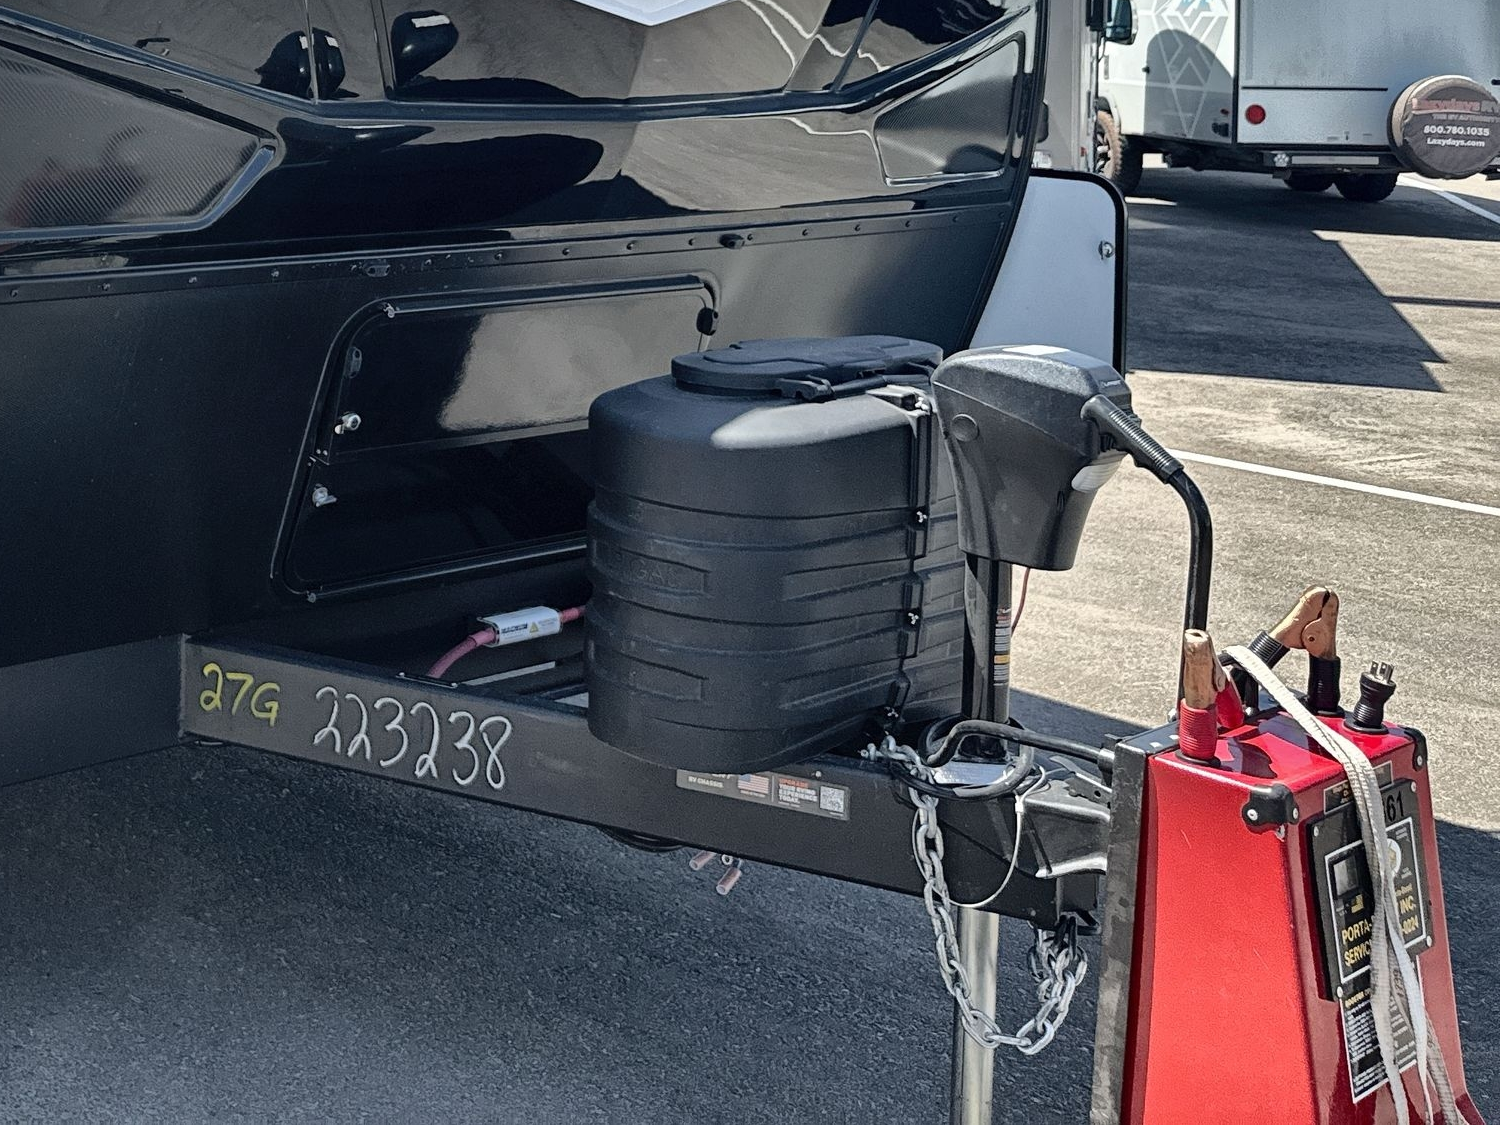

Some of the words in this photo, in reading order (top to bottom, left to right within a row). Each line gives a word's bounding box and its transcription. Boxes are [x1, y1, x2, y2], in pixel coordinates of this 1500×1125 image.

[1423, 125, 1490, 136] 800.780.1035
[1426, 137, 1485, 147] Lazydays.com
[200, 662, 280, 726] 27G
[313, 686, 512, 788] 223238
